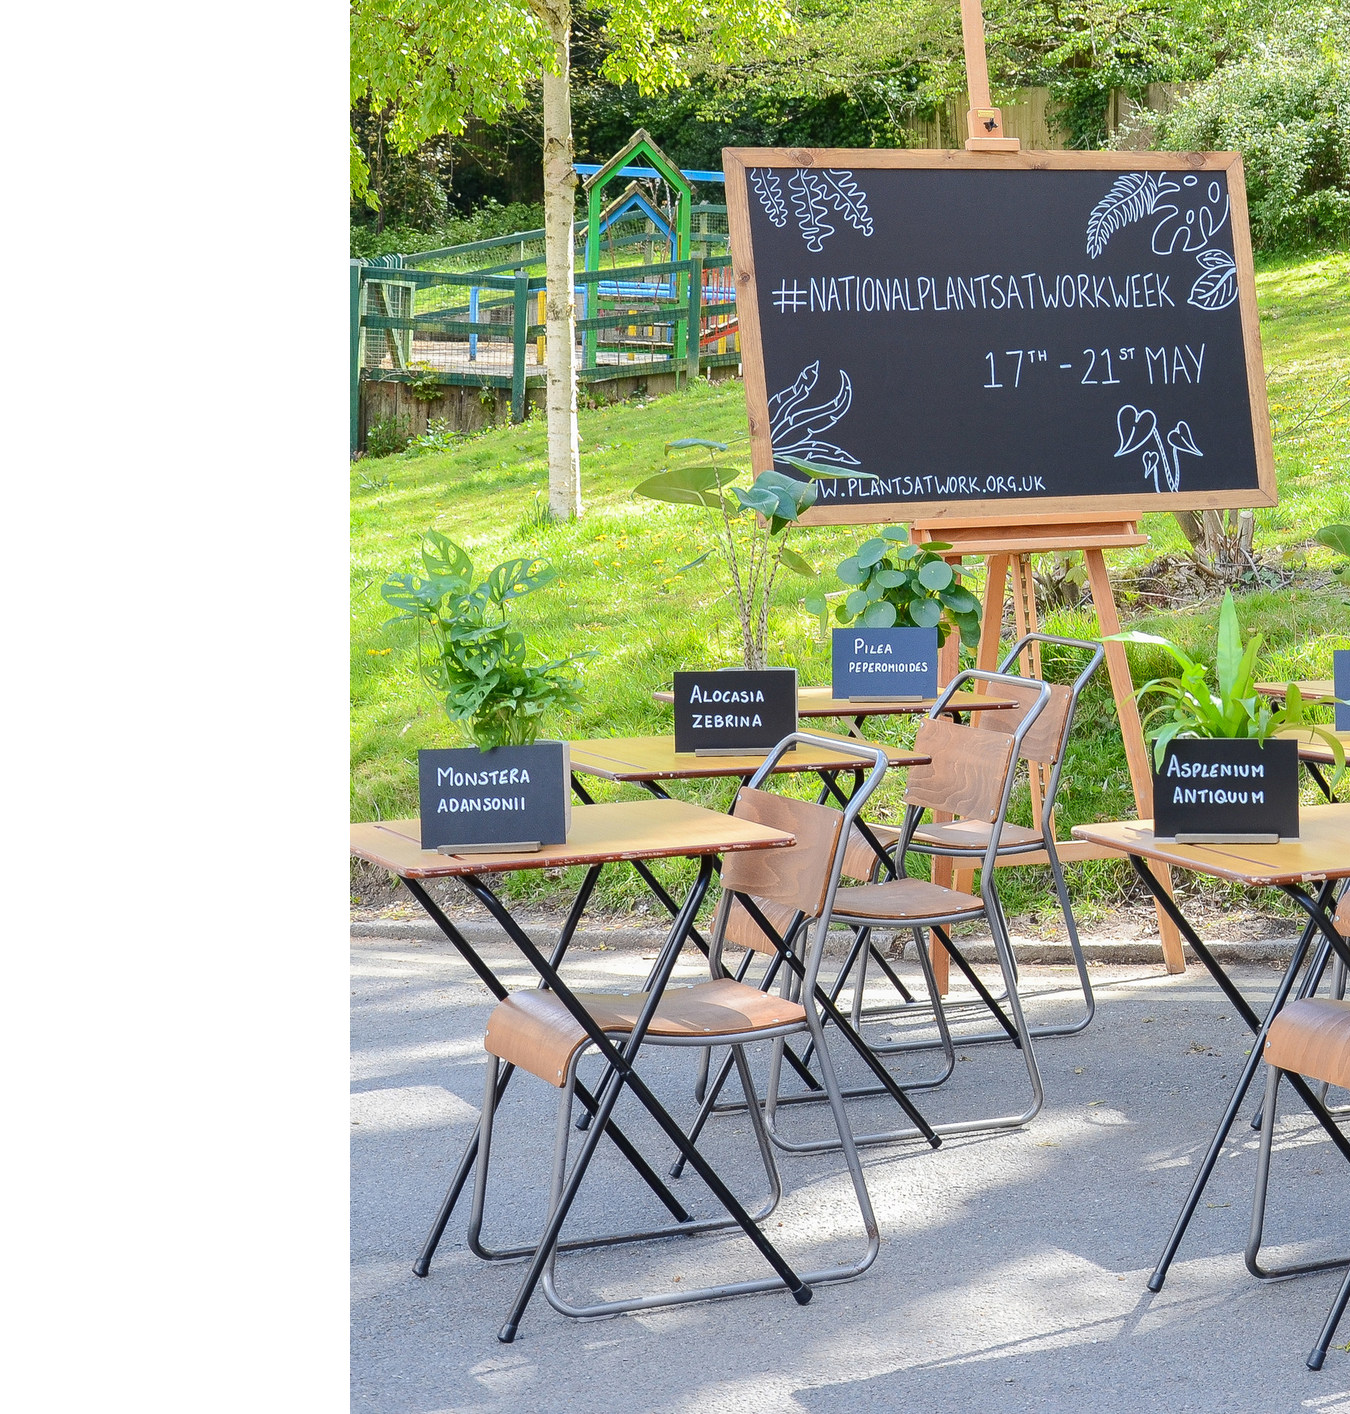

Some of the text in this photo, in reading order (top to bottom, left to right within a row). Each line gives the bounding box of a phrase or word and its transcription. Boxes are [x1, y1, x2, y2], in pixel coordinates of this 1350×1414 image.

[772, 273, 1175, 313] #NATIONALPLANTSATWORKWEEK
[984, 350, 1047, 388] 17TH
[1081, 348, 1135, 385] 21ST
[1145, 343, 1205, 384] MAY
[815, 475, 1046, 498] W.PLANTSATWORK.ORG.UK
[854, 637, 893, 655] PILEA
[848, 661, 929, 673] PEPEROMIOIDES
[690, 684, 765, 704] ALOCASIA
[692, 713, 763, 729] ZEBRINA
[1166, 754, 1265, 778] ASPLENIUM
[437, 766, 530, 787] MONSTERA
[437, 796, 526, 814] ADANSONII
[1172, 786, 1265, 804] ANTIQUUM
